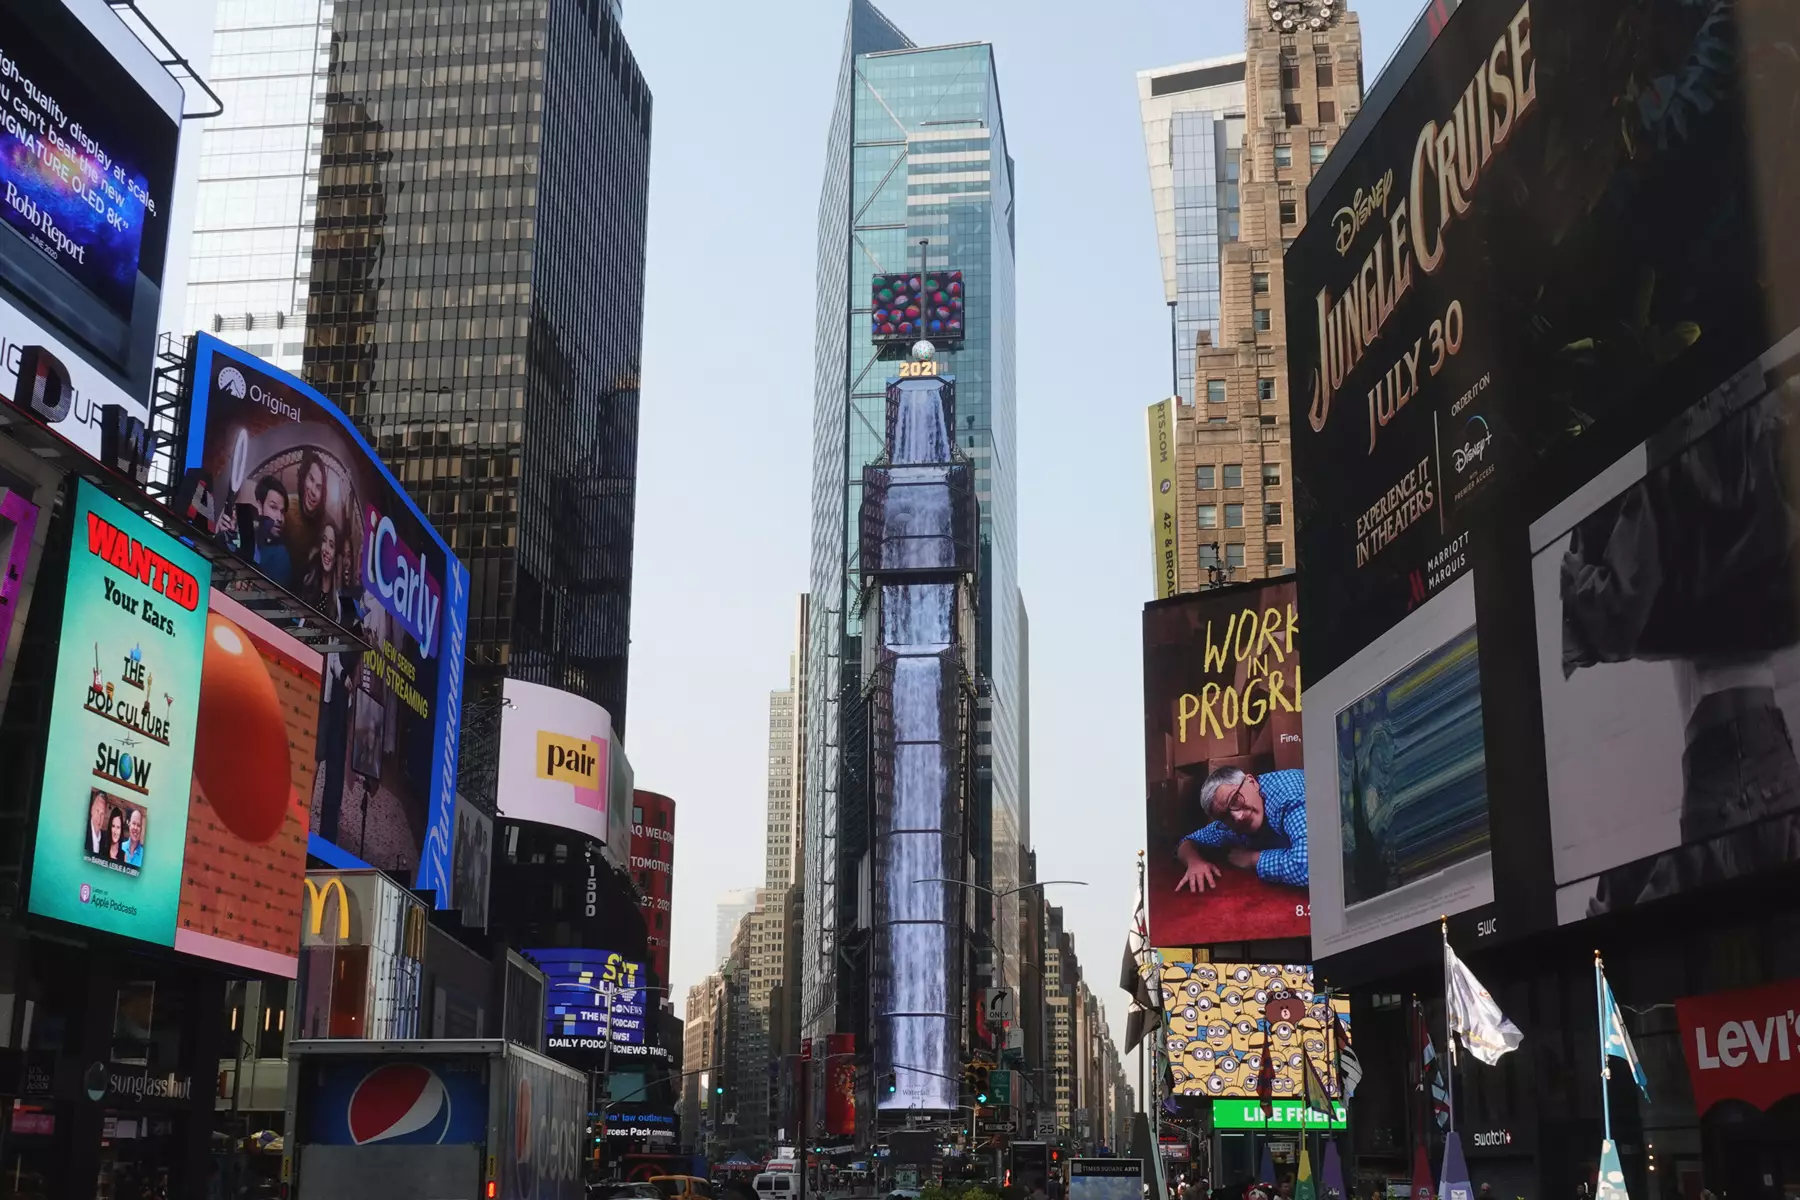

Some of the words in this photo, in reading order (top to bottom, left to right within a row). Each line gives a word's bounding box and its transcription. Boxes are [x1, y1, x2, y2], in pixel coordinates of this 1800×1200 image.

[13, 97, 46, 134] can't
[48, 123, 76, 164] beat
[80, 157, 98, 184] the
[101, 179, 125, 207] new
[70, 122, 112, 171] display
[114, 161, 126, 184] at
[128, 178, 157, 217] scale,
[71, 176, 105, 214] OLED
[5, 180, 41, 223] Robb
[41, 212, 85, 265] Report
[1308, 197, 1412, 433] JUNGLE
[1410, 0, 1537, 273] CRUISE
[29, 234, 45, 250] JUNE
[900, 361, 937, 376] 2021
[1368, 337, 1422, 455] JULY
[1429, 300, 1463, 376] 30
[250, 384, 301, 424] Original
[1451, 388, 1473, 417] ORDER
[1472, 381, 1480, 398] IT
[1480, 372, 1491, 390] ON
[1357, 469, 1416, 539] EXPERIENCE
[1418, 456, 1429, 485] IT
[1454, 478, 1475, 502] PREMIER
[1475, 463, 1495, 485] ACCESS
[1165, 538, 1173, 548] &
[1356, 540, 1369, 569] IN
[1368, 481, 1434, 556] THEATERS
[87, 510, 200, 612] WANTED
[1428, 531, 1470, 573] MARRIOTT
[1429, 553, 1466, 590] MARQUIS
[367, 510, 439, 659] iCarly
[104, 577, 138, 615] Your
[142, 599, 176, 638] Ears.
[123, 656, 146, 684] THE
[383, 638, 396, 663] NEW
[397, 653, 416, 682] SERIES
[1248, 653, 1269, 679] IN
[363, 650, 386, 679] NOW
[385, 667, 429, 719] STREAMING
[88, 686, 113, 714] POP
[117, 700, 170, 741] CULTURE
[96, 742, 151, 789] SHOW
[547, 743, 595, 776] pair
[91, 894, 110, 909] Apple
[110, 899, 138, 916] Podcasts
[585, 865, 596, 917] 1500
[580, 1011, 598, 1021] THE
[990, 1011, 1009, 1019] ONLY
[549, 1038, 578, 1047] DAILY
[622, 1113, 636, 1122] law
[1039, 1124, 1055, 1134] 25
[1474, 1129, 1506, 1146] swatch
